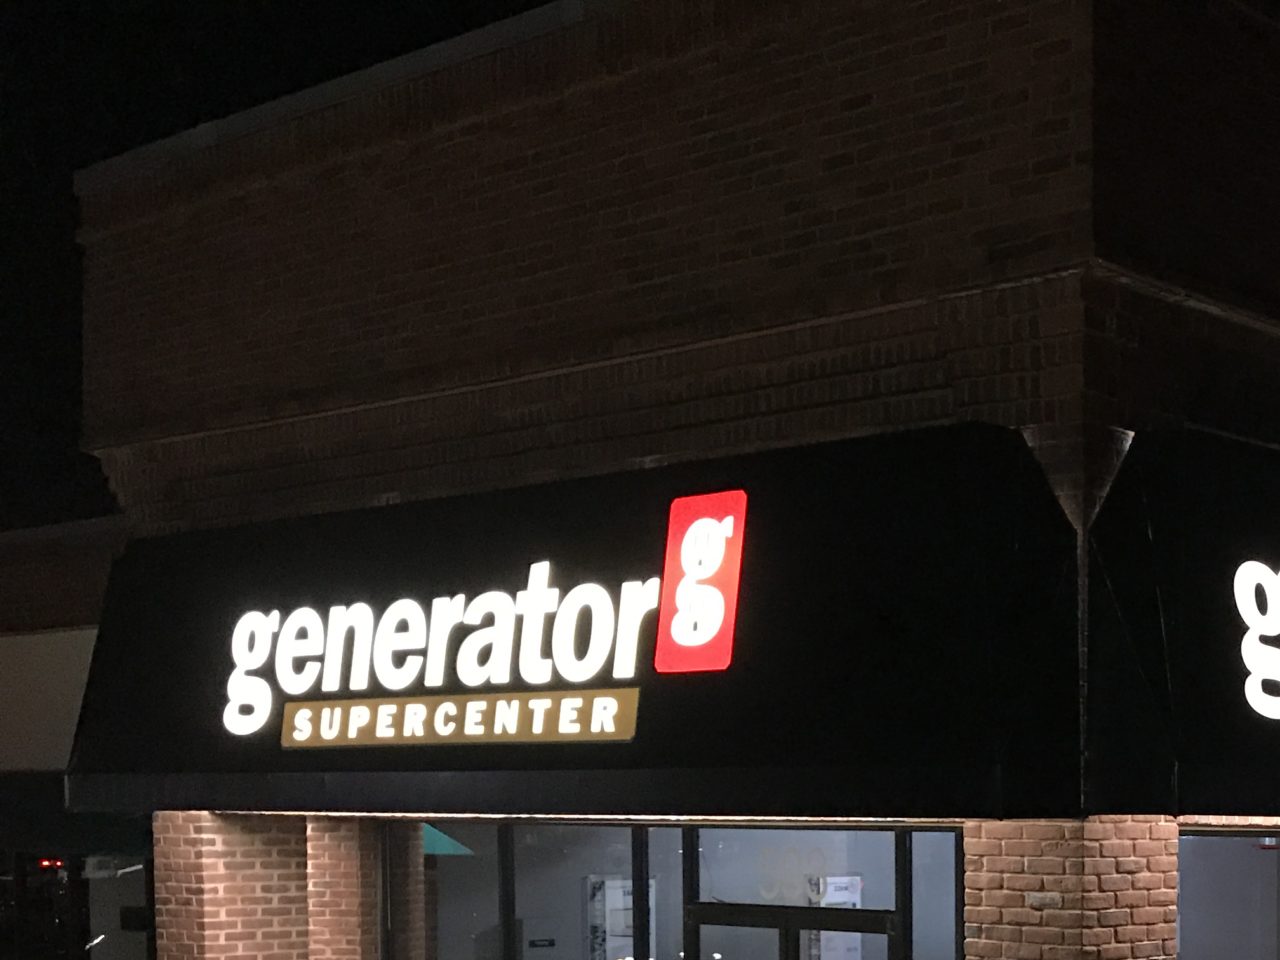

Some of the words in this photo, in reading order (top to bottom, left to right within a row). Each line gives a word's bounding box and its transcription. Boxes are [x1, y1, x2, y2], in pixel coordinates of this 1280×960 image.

[222, 560, 661, 736] generator
[670, 516, 734, 647] g
[292, 696, 619, 742] SUPERCENTER
